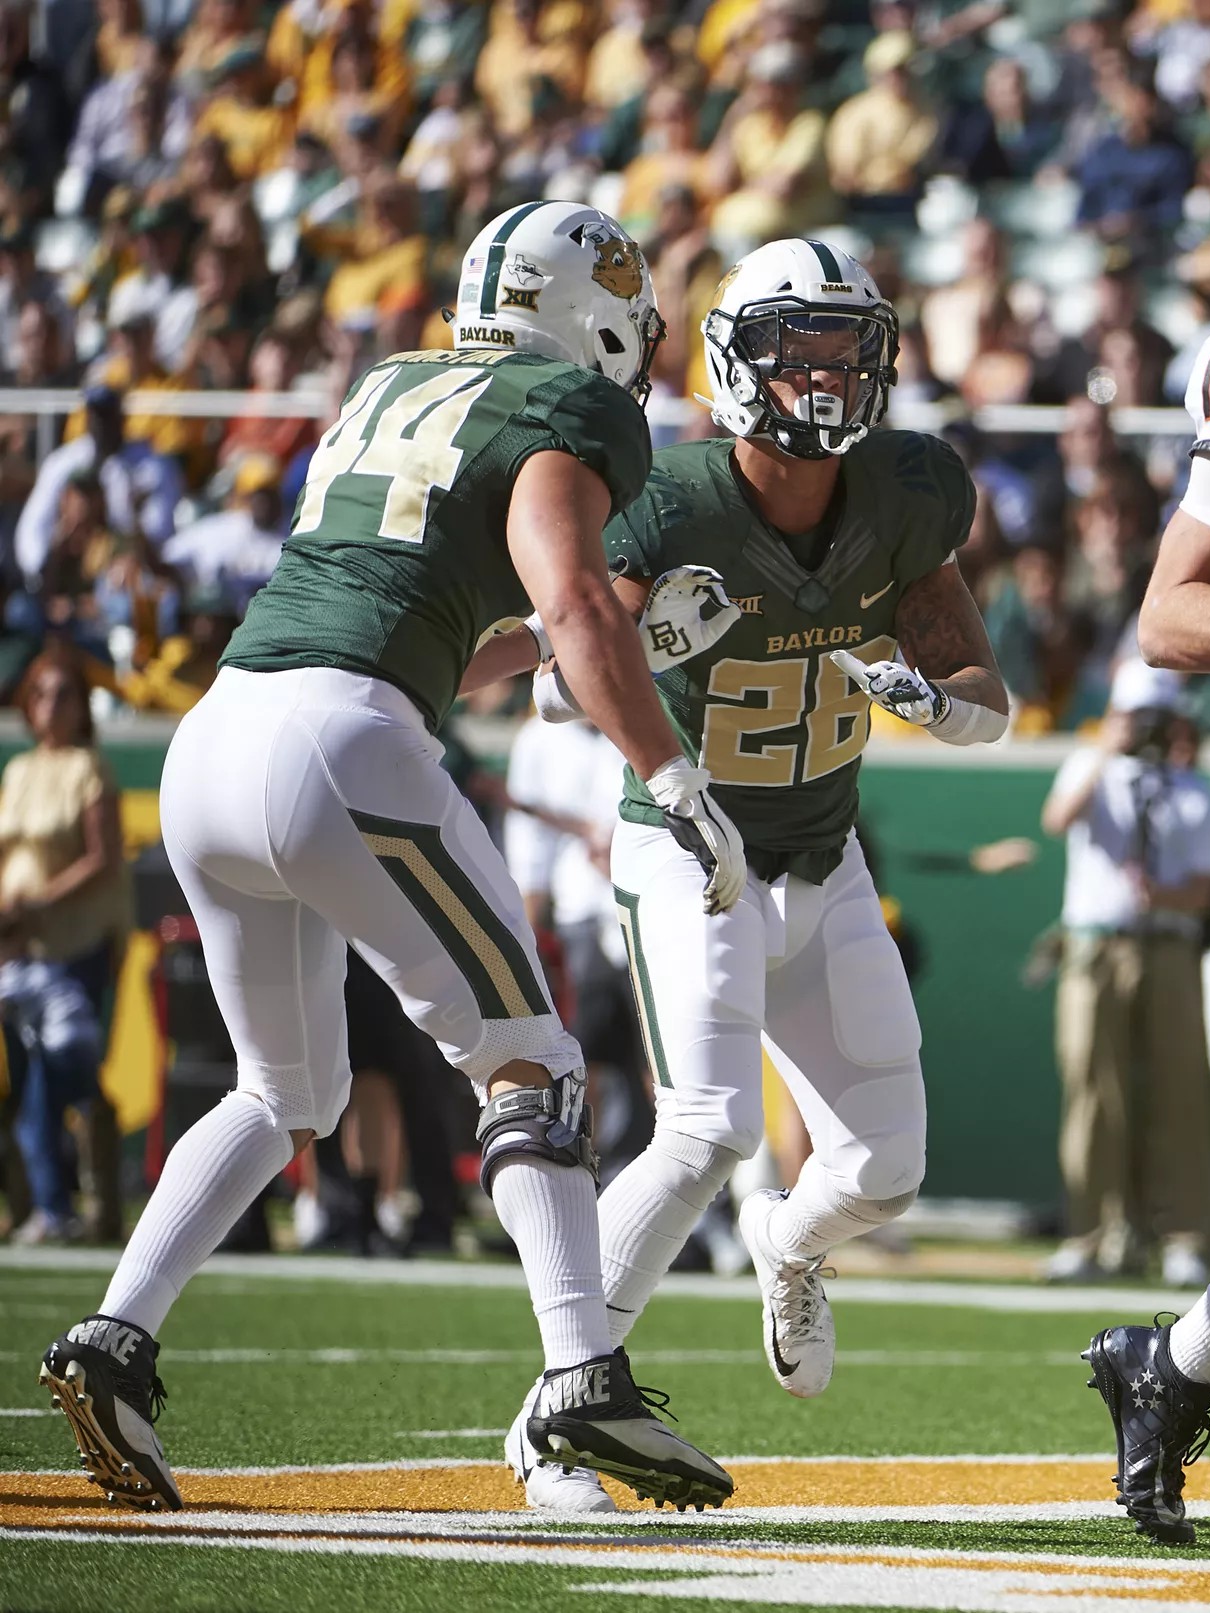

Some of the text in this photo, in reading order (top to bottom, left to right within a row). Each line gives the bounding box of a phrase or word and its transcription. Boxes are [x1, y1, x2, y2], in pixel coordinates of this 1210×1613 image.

[499, 284, 543, 313] XII
[820, 284, 853, 293] BEARS
[460, 326, 515, 346] BAYLOR
[291, 364, 493, 544] 44
[647, 620, 692, 657] BU
[767, 625, 863, 654] BAYLOR
[66, 1320, 143, 1367] NIKE
[540, 1362, 610, 1419] NIKE
